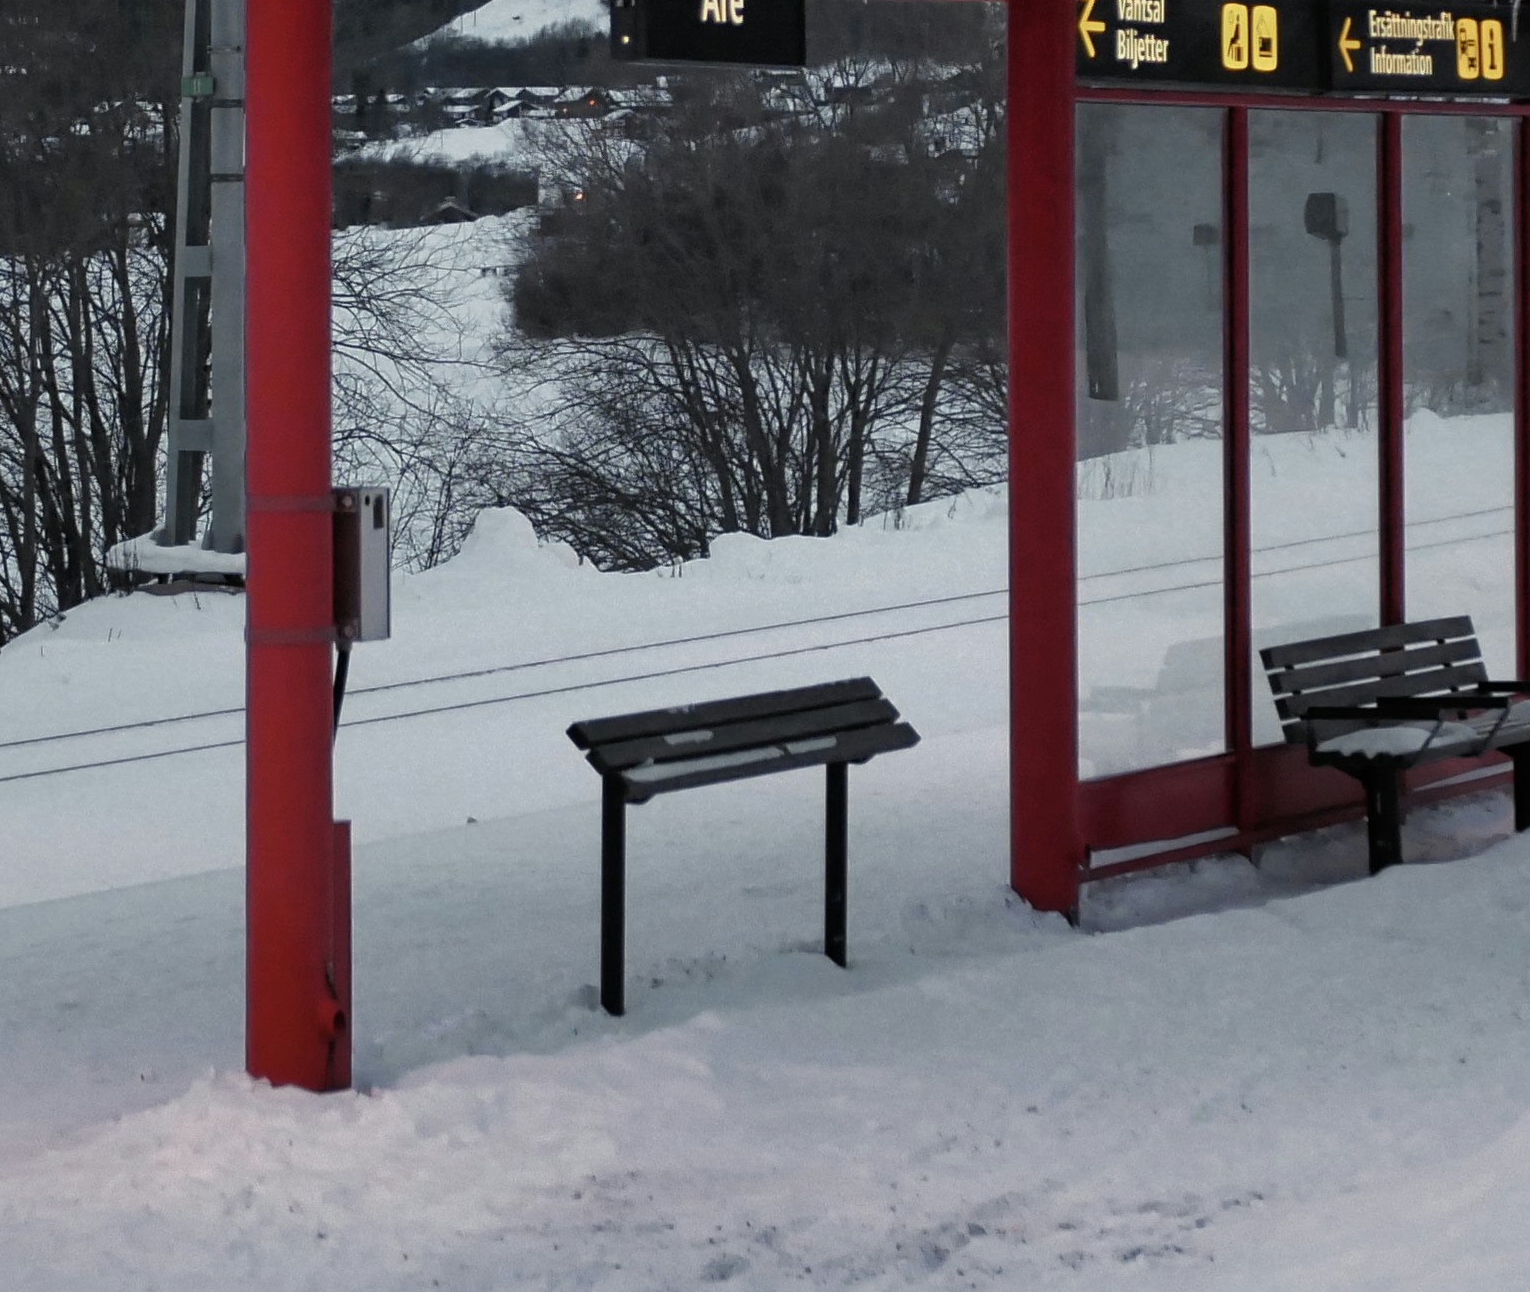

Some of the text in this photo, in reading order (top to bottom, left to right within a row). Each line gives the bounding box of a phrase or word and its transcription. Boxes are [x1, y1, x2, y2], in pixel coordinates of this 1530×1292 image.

[1369, 9, 1455, 46] Ersättningstrafik
[1116, 28, 1169, 69] Biljetter
[1370, 45, 1433, 75] Information
